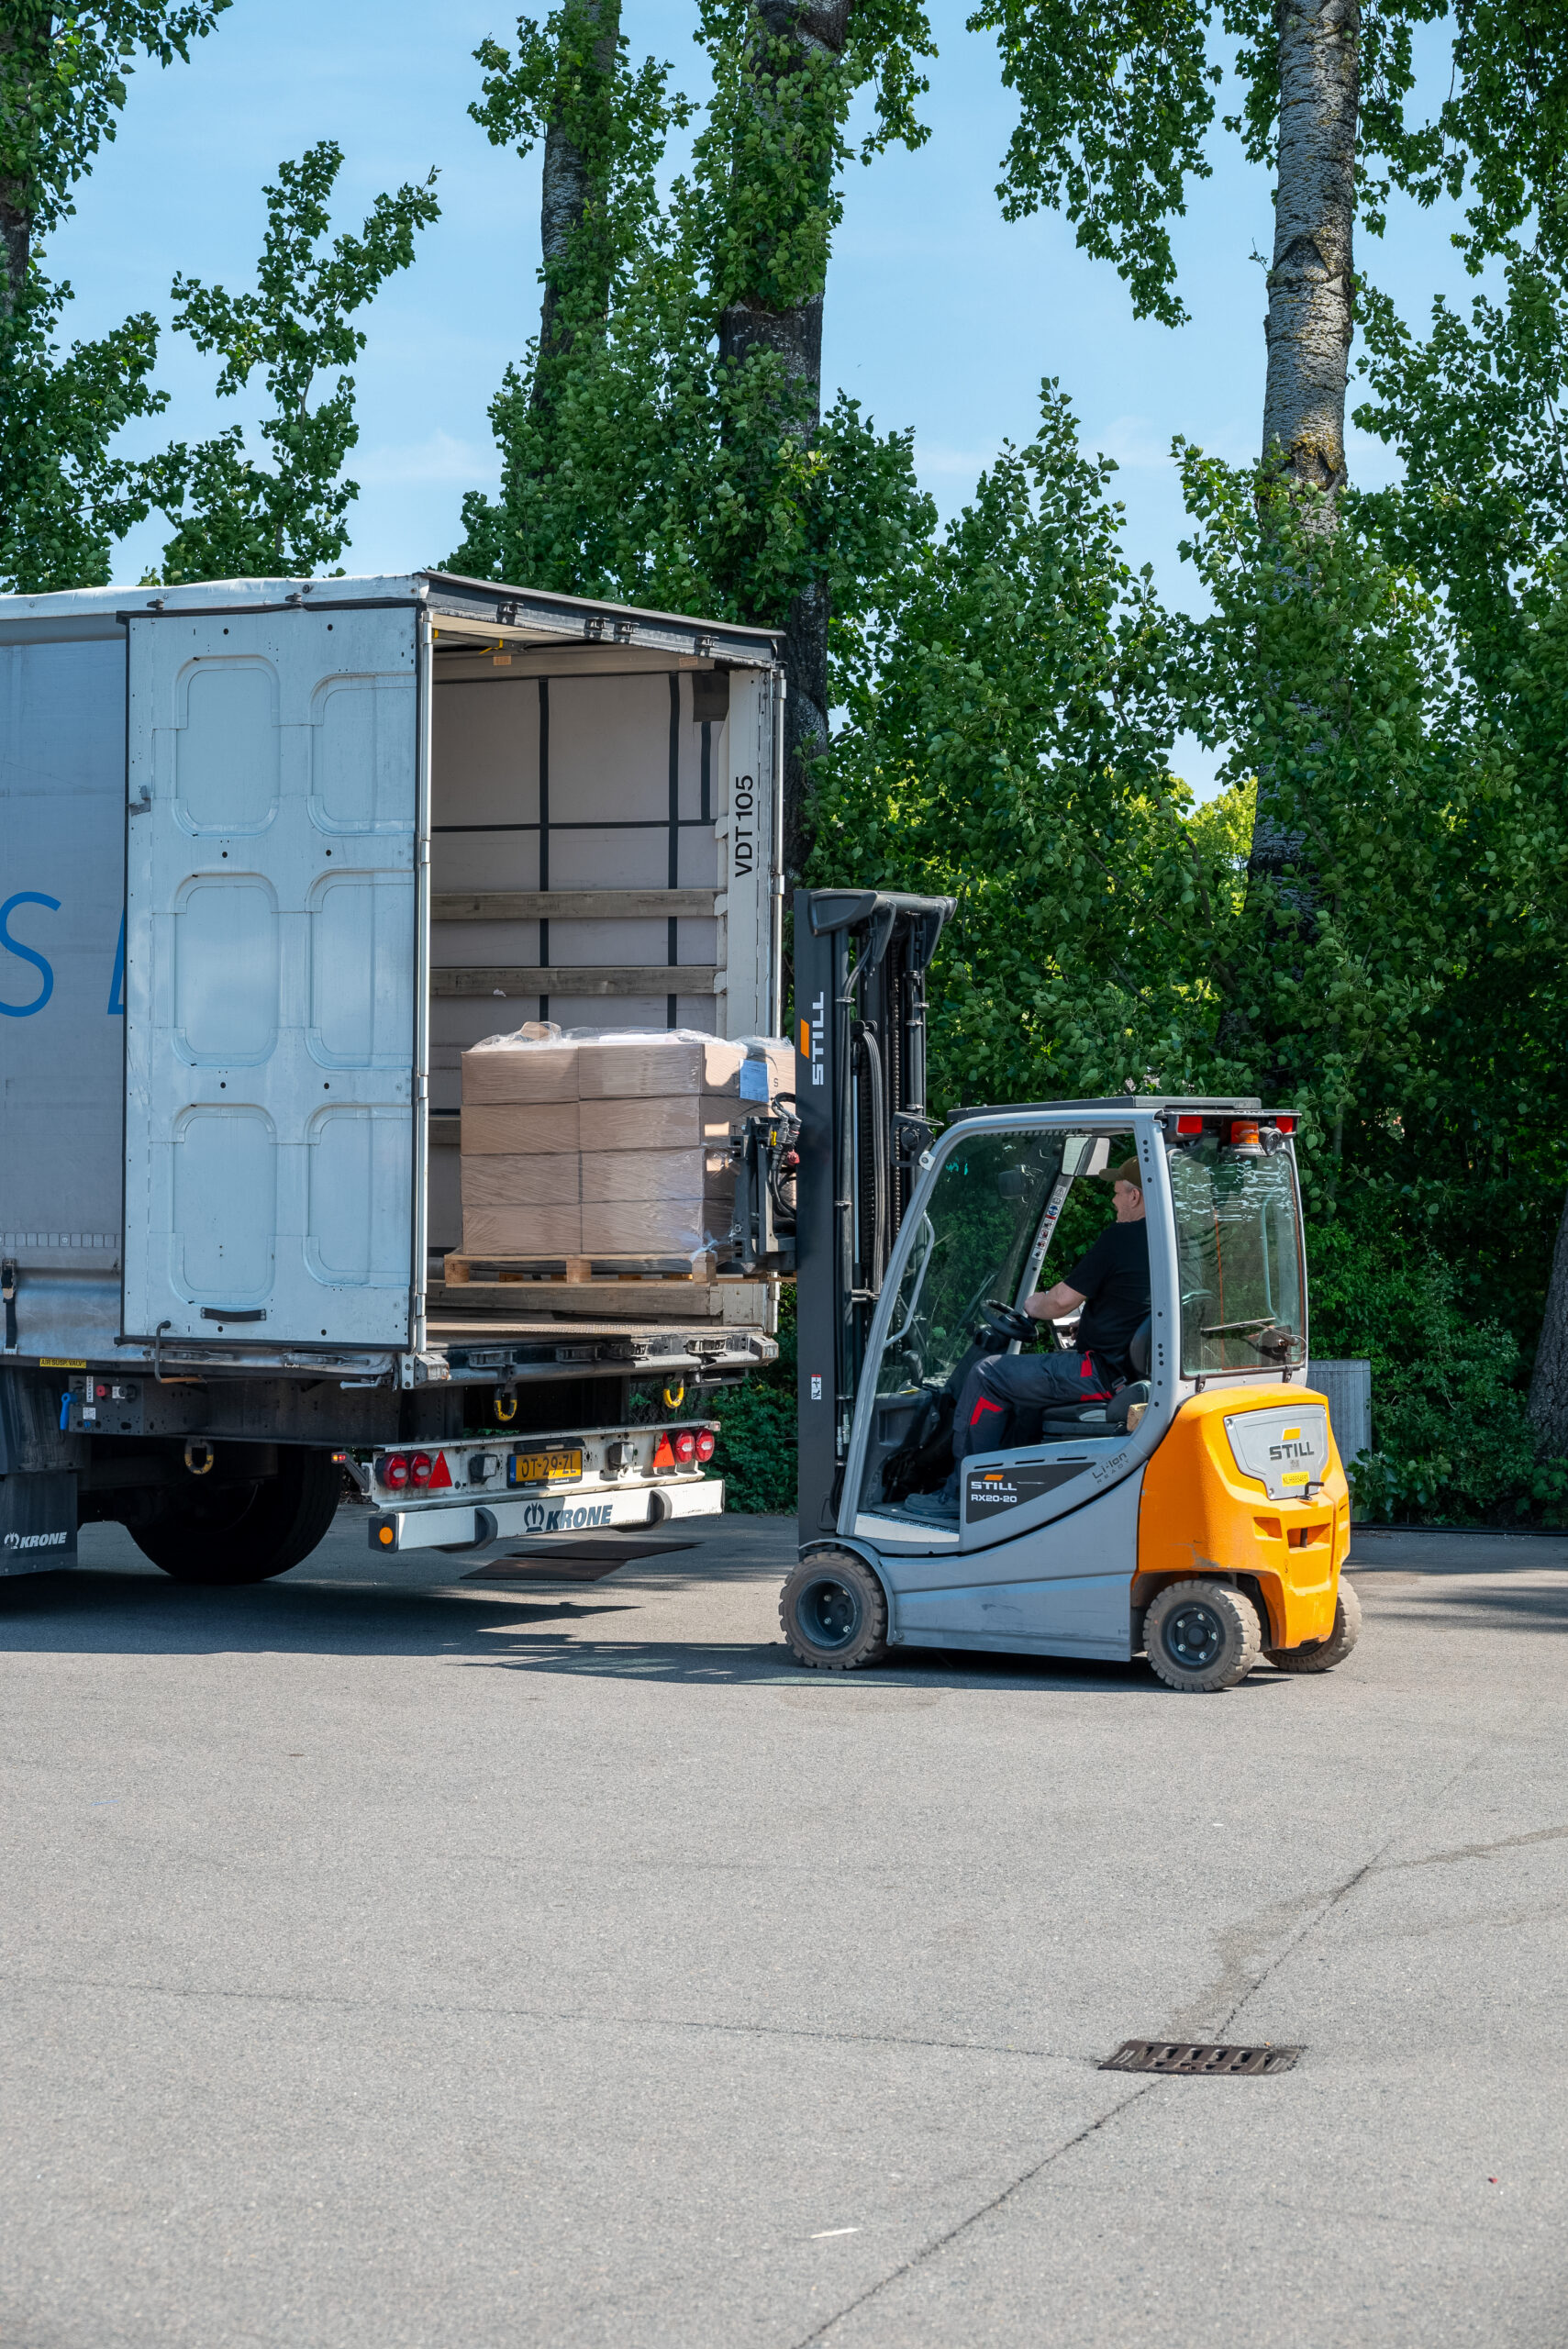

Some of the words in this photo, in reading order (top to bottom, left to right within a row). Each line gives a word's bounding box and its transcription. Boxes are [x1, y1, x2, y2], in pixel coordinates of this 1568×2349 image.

[735, 774, 753, 822] 105
[735, 826, 752, 877] VDT
[812, 991, 824, 1085] STILL
[1269, 1442, 1314, 1461] STILL
[521, 1453, 576, 1478] OT-29-ZL
[1092, 1453, 1127, 1479] Li-Ion
[971, 1481, 1018, 1491] STILL
[971, 1494, 1018, 1503] RX20-20
[545, 1504, 613, 1531] KRONE
[19, 1531, 67, 1549] KRONE
